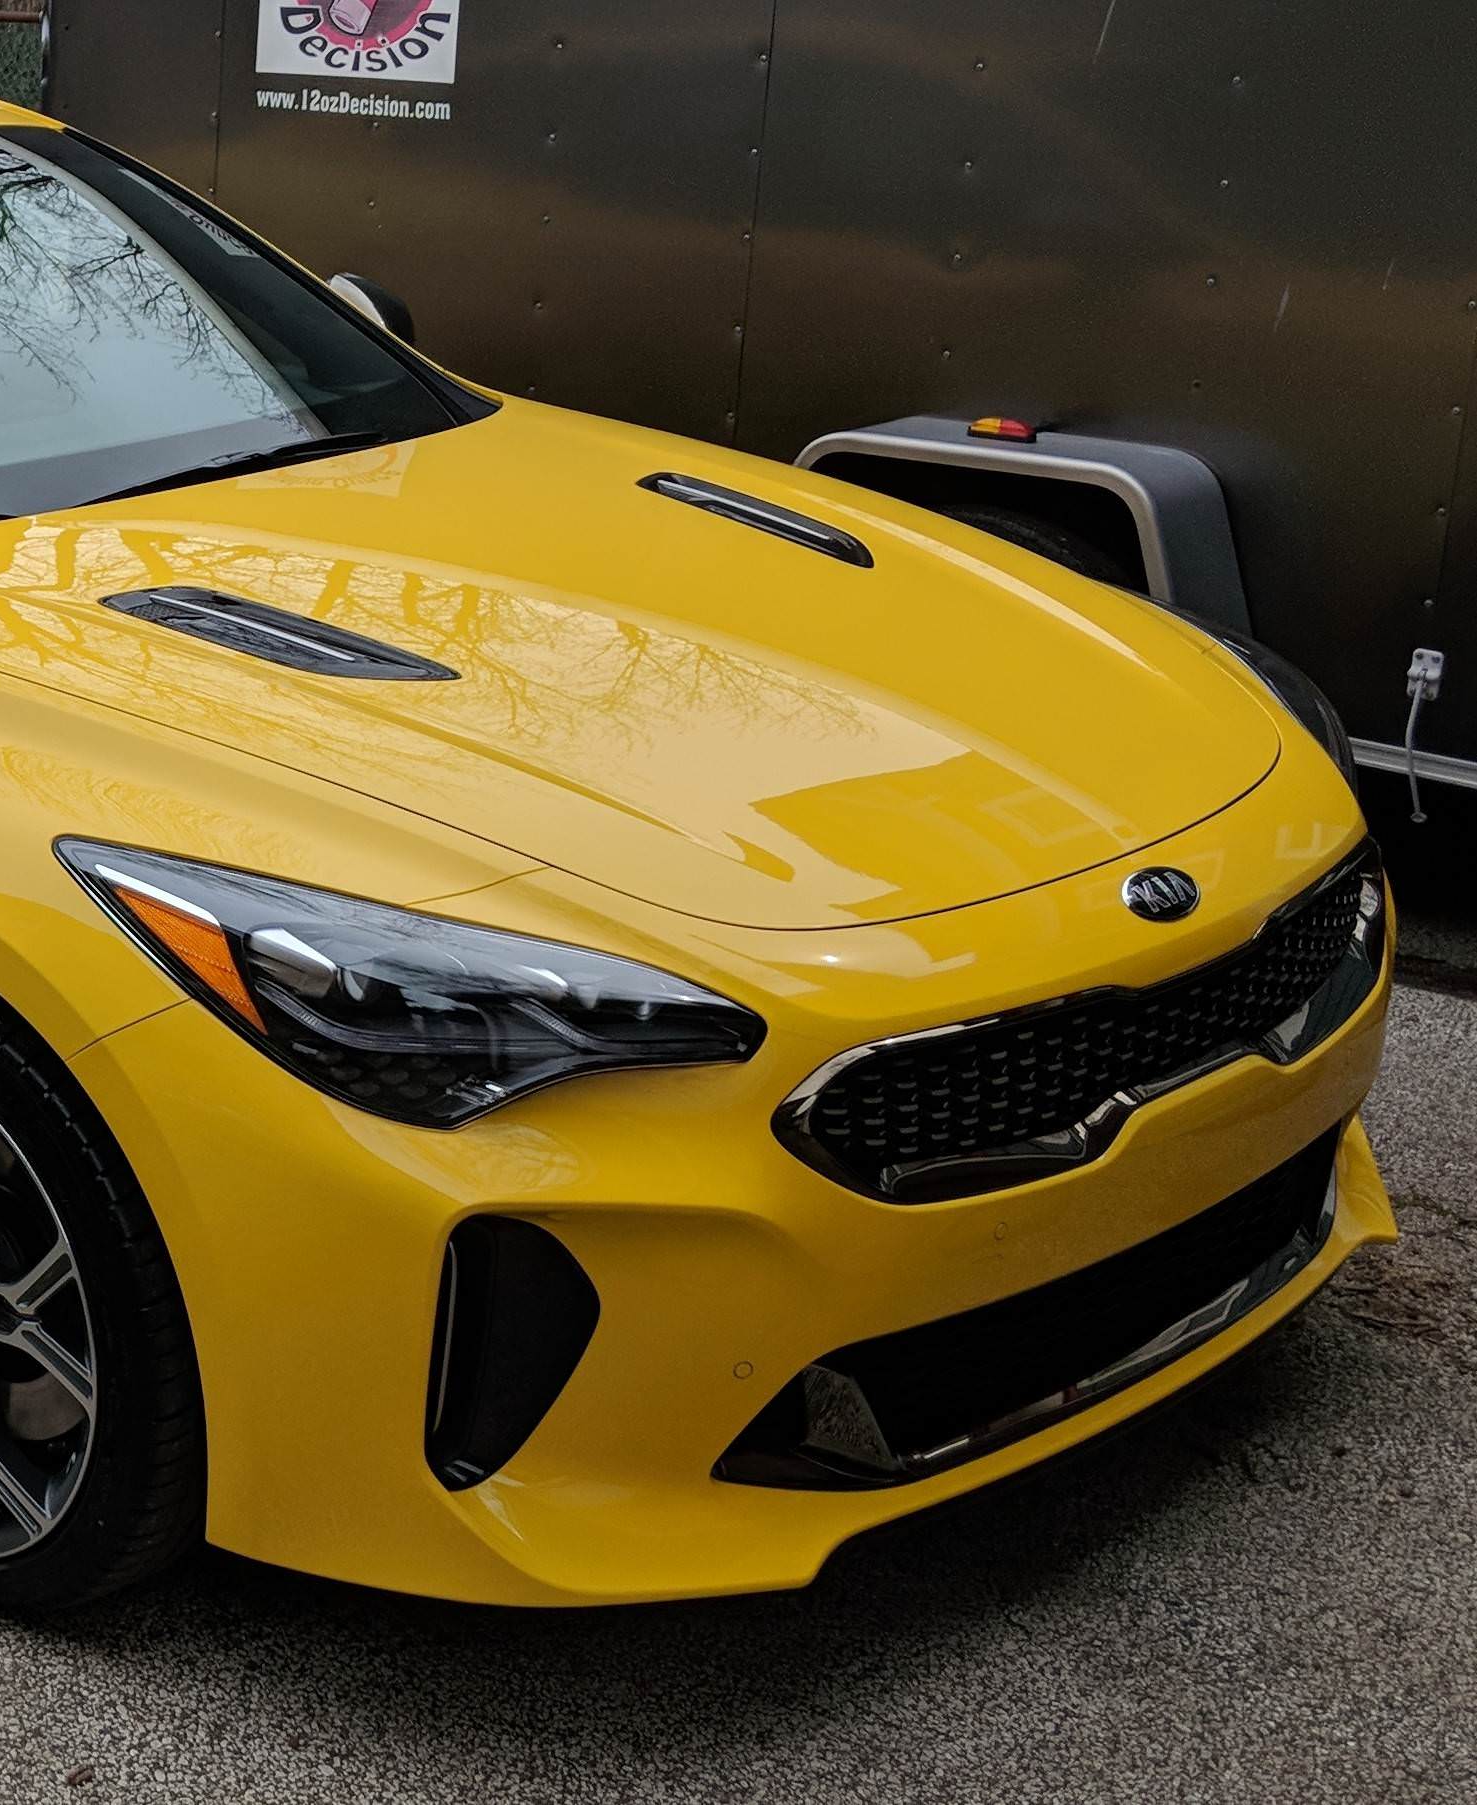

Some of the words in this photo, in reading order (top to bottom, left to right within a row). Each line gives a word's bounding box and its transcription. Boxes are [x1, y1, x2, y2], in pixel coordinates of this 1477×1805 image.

[280, 7, 451, 72] Decision
[256, 88, 451, 120] www.12ozDecision.com
[1130, 871, 1196, 913] KIA
